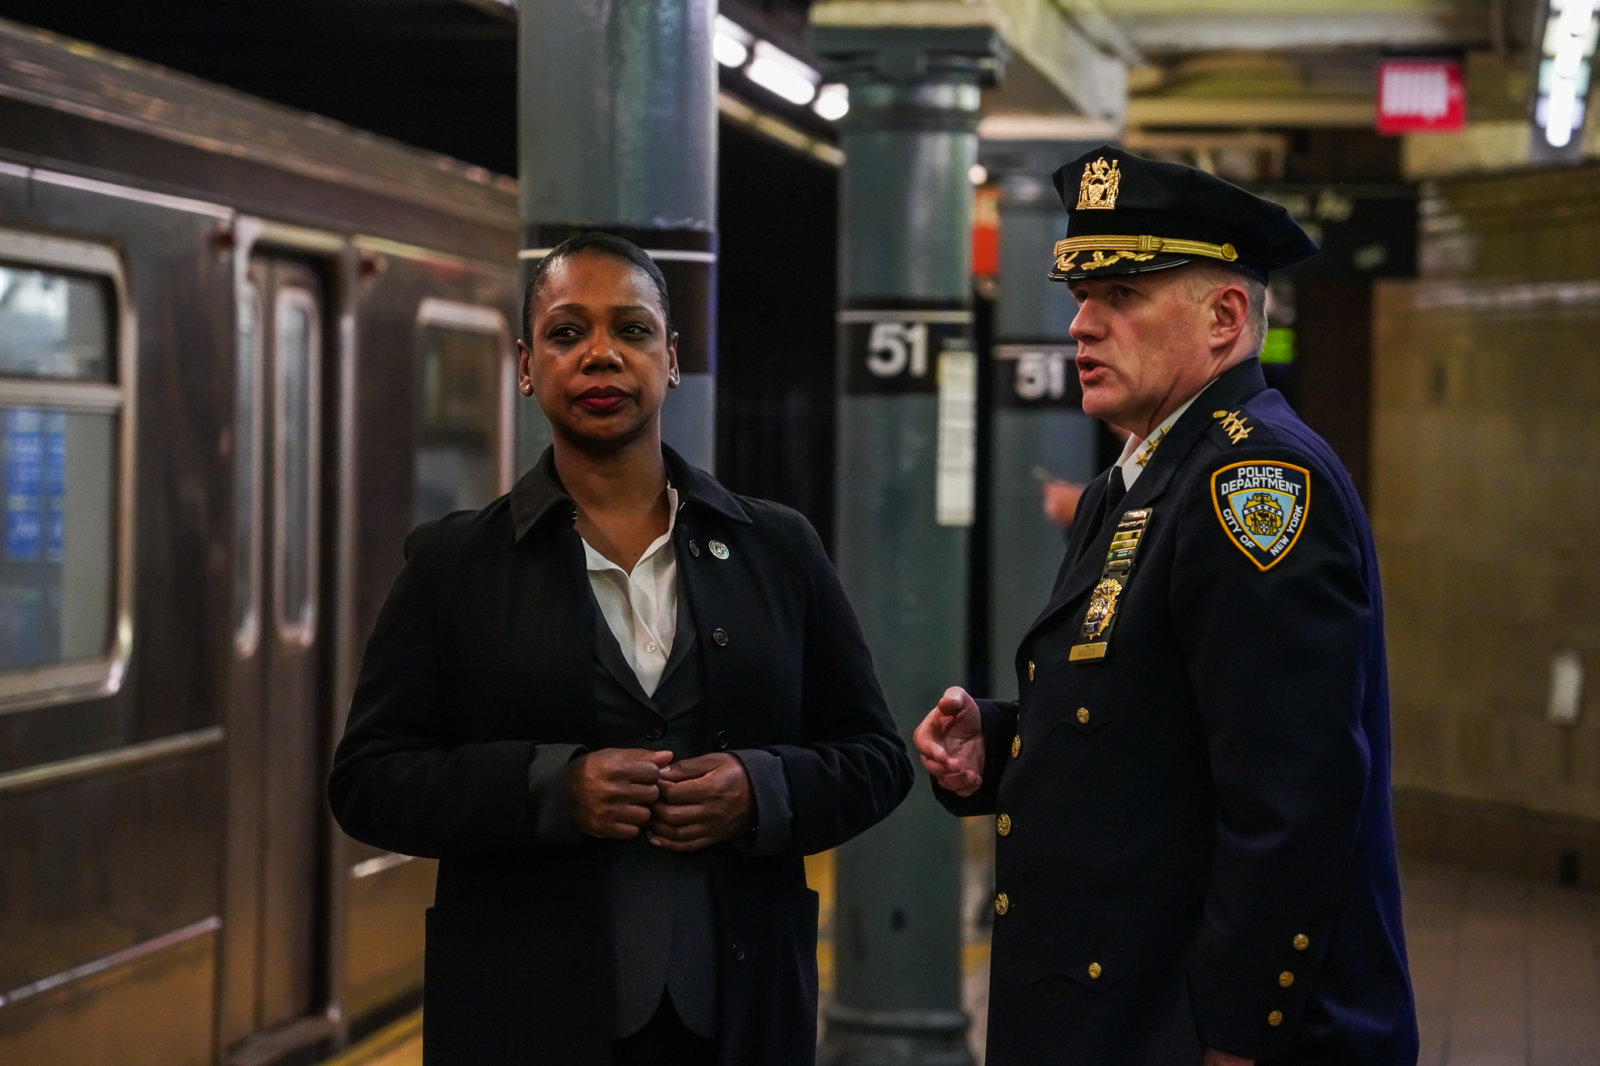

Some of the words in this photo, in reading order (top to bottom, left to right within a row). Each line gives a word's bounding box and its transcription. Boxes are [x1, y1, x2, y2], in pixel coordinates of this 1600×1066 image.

[867, 322, 928, 376] 51
[1015, 353, 1064, 398] 51
[1221, 477, 1301, 496] DEPARTMENT
[1237, 466, 1283, 479] POLICE
[1222, 508, 1242, 533] CITY
[1239, 534, 1255, 549] OF
[1270, 535, 1289, 556] NEW
[1286, 505, 1303, 533] YORK
